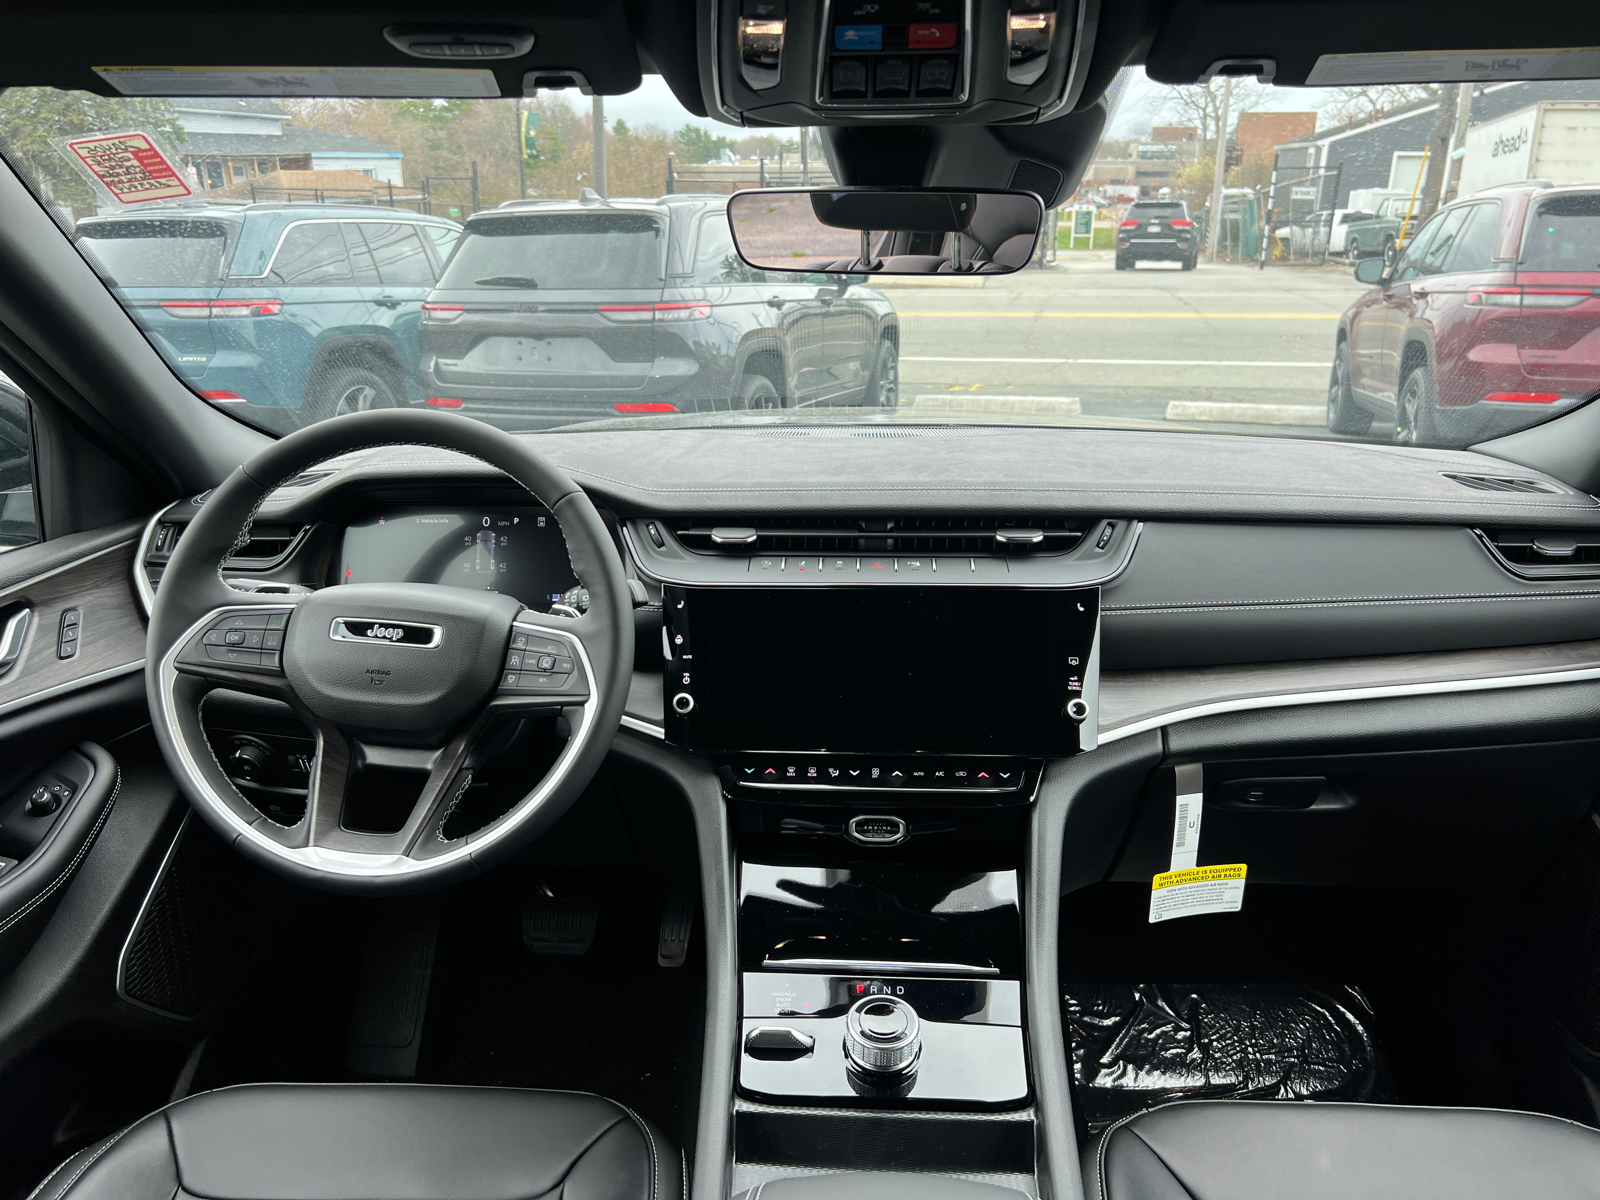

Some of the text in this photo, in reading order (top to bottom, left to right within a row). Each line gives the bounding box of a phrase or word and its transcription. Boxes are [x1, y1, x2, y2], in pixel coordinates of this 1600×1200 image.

[513, 517, 520, 525] P
[463, 535, 472, 543] 40
[500, 535, 508, 543] 42
[366, 624, 404, 641] Jeep
[365, 668, 392, 676] AIRBAG
[1158, 874, 1173, 882] THIS
[1174, 870, 1200, 879] VEHICLE
[1158, 880, 1174, 888] WITH
[1175, 875, 1210, 884] ADVANCED
[856, 984, 905, 995] P R N D
